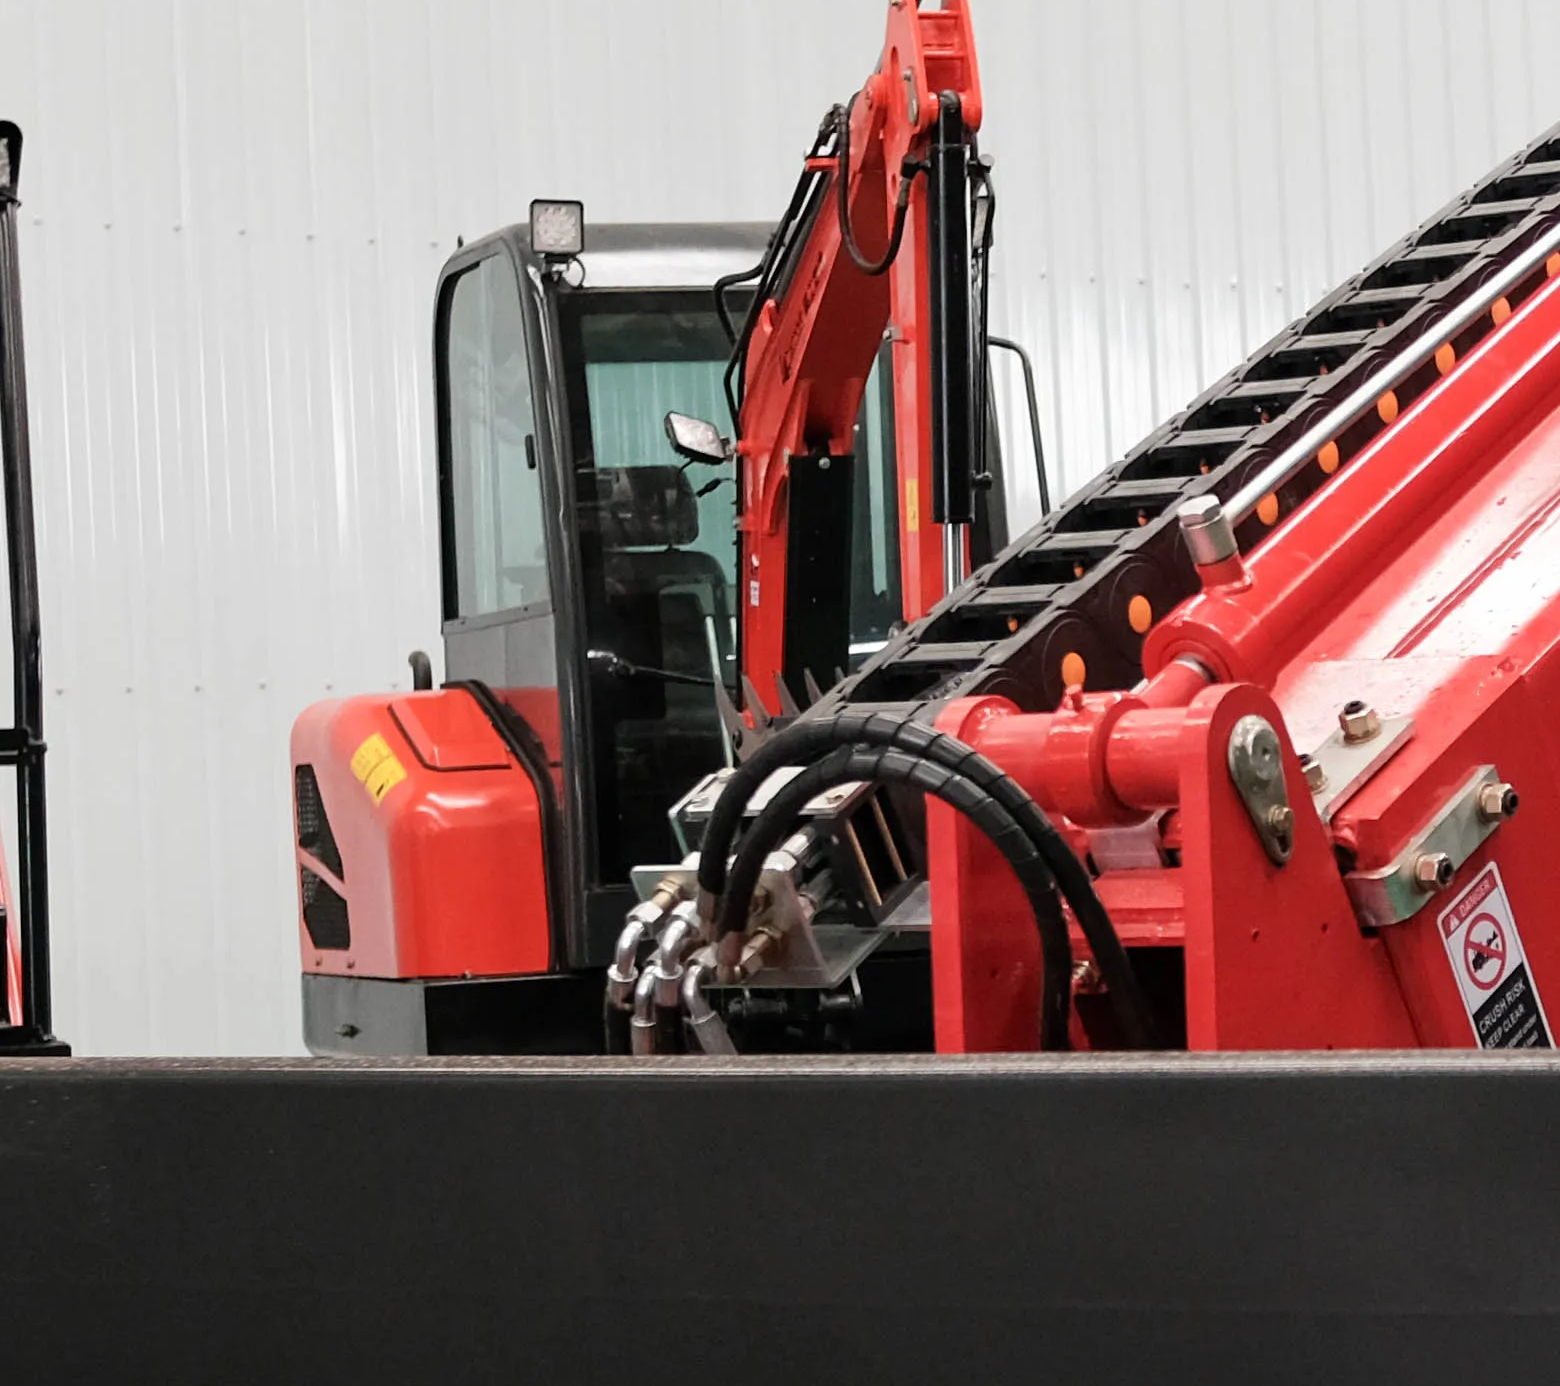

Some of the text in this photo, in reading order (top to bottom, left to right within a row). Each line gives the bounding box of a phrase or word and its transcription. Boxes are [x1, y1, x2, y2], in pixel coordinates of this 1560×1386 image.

[1478, 978, 1527, 1034] CRUSH RISK
[1502, 1003, 1526, 1033] CLEAR
